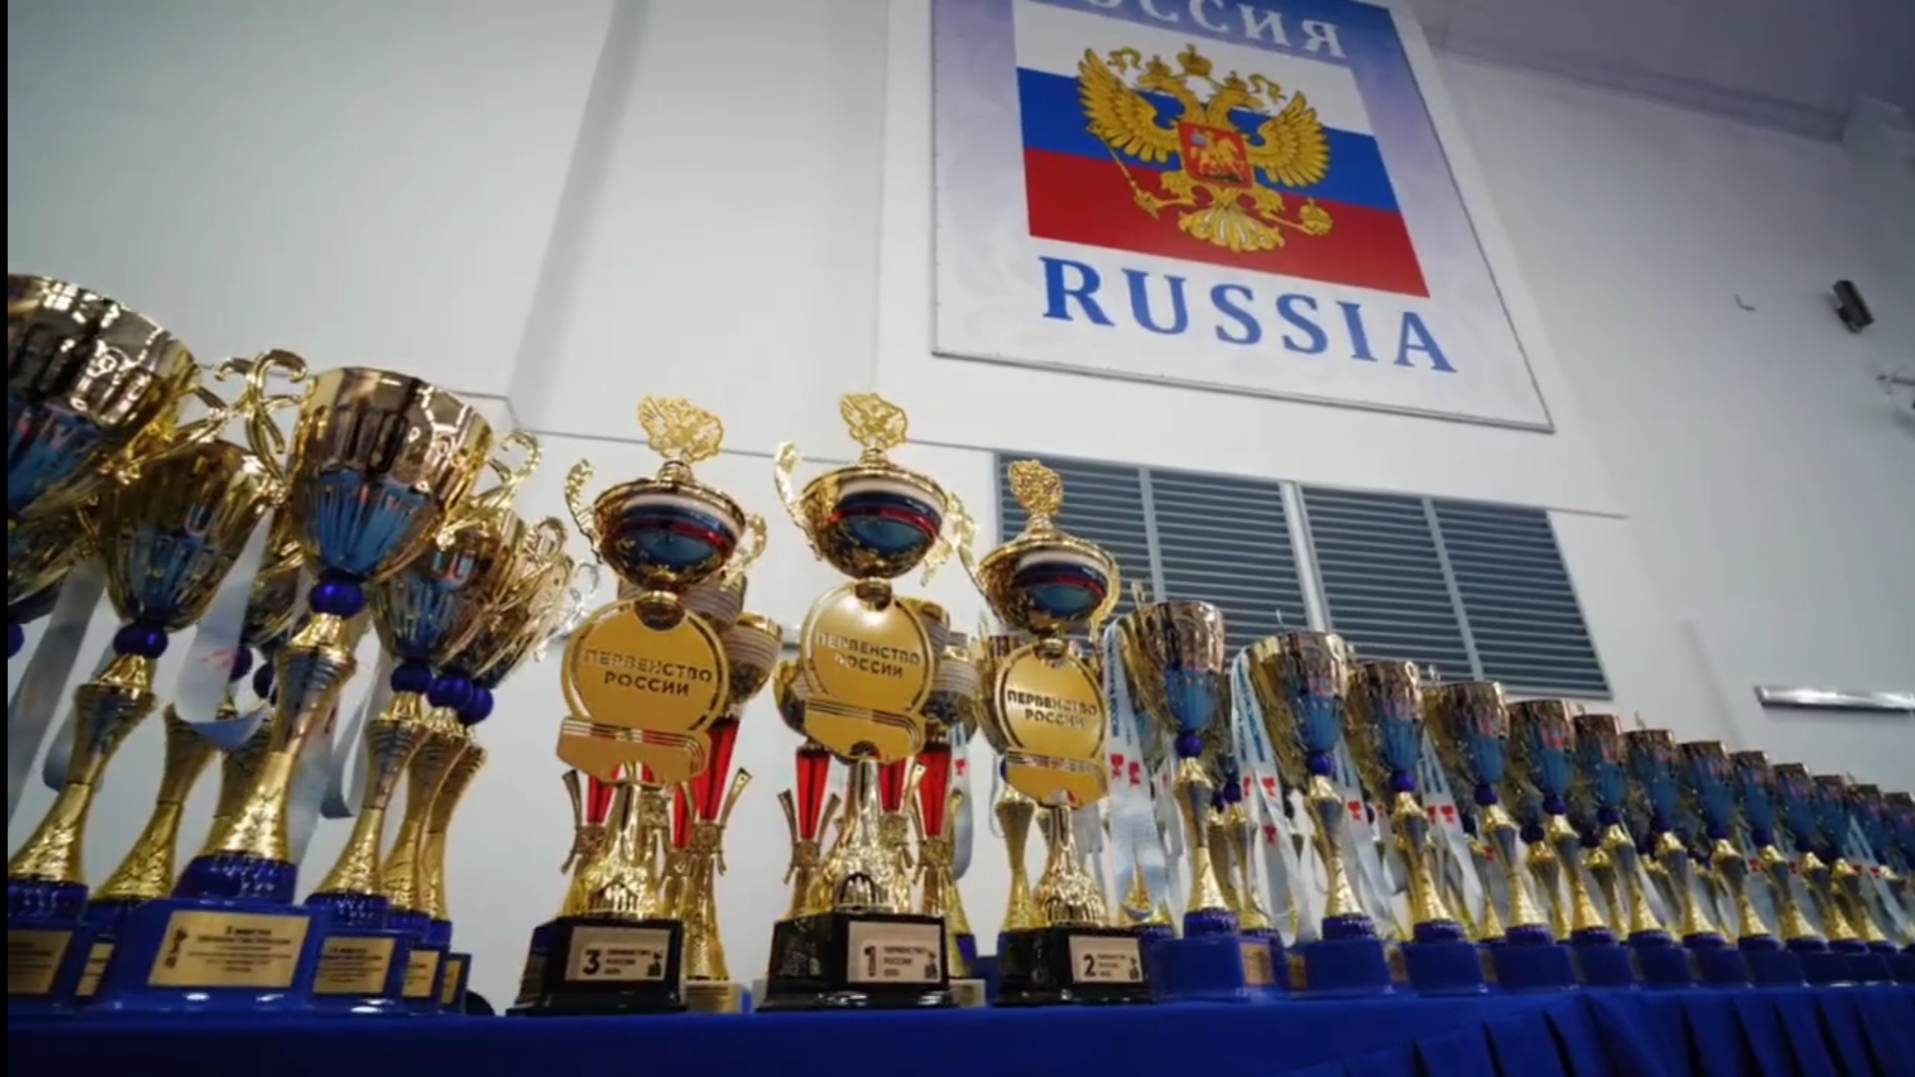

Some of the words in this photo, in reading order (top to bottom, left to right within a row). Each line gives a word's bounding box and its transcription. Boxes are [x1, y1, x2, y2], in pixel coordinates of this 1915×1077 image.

[1088, 0, 1346, 59] ССИЯ
[1038, 255, 1458, 374] RUSSIA
[818, 630, 921, 665] ПЕРВЕНСТВО
[583, 649, 713, 683] ПЕРВЕНСТВО
[834, 653, 904, 679] РОССИИ
[603, 670, 690, 697] РОССИИ
[1006, 689, 1098, 717] ПЕРВЕНСТВО
[582, 948, 601, 976] 3
[864, 945, 876, 978] 1
[1083, 953, 1097, 978] 2
